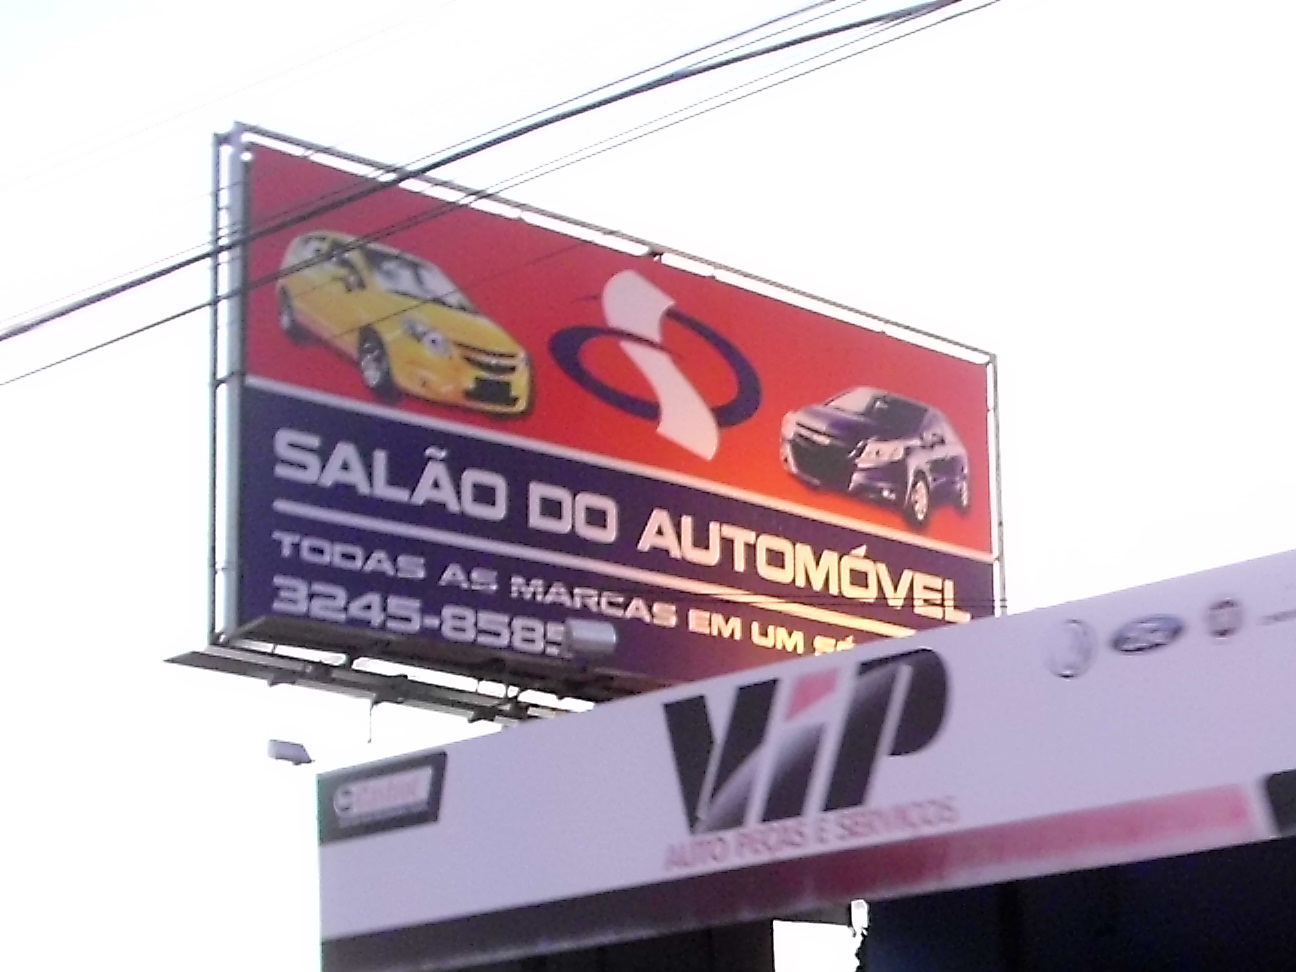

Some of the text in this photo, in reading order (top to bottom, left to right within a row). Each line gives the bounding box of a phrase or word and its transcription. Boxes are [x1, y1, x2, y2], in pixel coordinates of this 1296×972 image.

[271, 531, 427, 579] TODAS
[438, 563, 498, 593] AS
[510, 575, 678, 628] MARCAS
[688, 608, 742, 640] EM
[751, 621, 804, 654] UM
[273, 428, 972, 624] SALÃO DO AUTOMÓVEL
